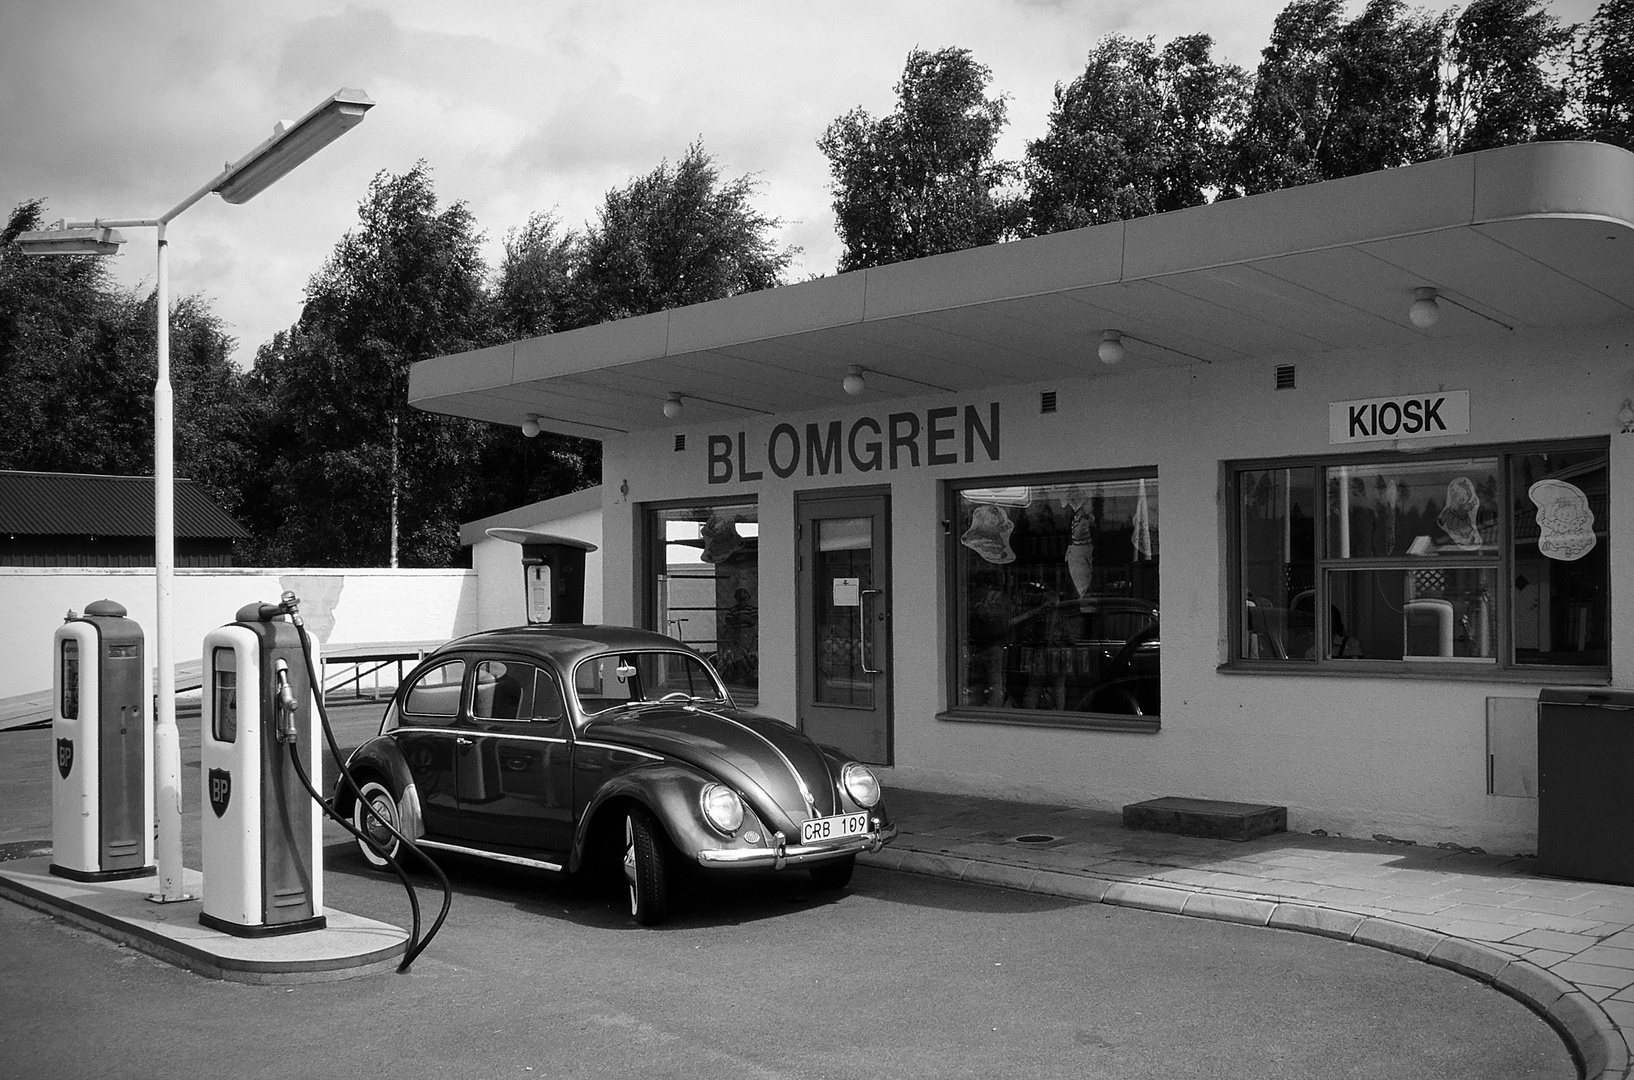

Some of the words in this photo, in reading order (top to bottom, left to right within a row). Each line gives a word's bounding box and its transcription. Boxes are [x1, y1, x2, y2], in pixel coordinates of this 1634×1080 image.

[1349, 397, 1447, 437] KIOSK
[708, 402, 1000, 484] BLOMGREN
[60, 746, 71, 767] BP
[213, 778, 228, 803] BP
[805, 821, 830, 840] CRB
[842, 816, 866, 834] 109
